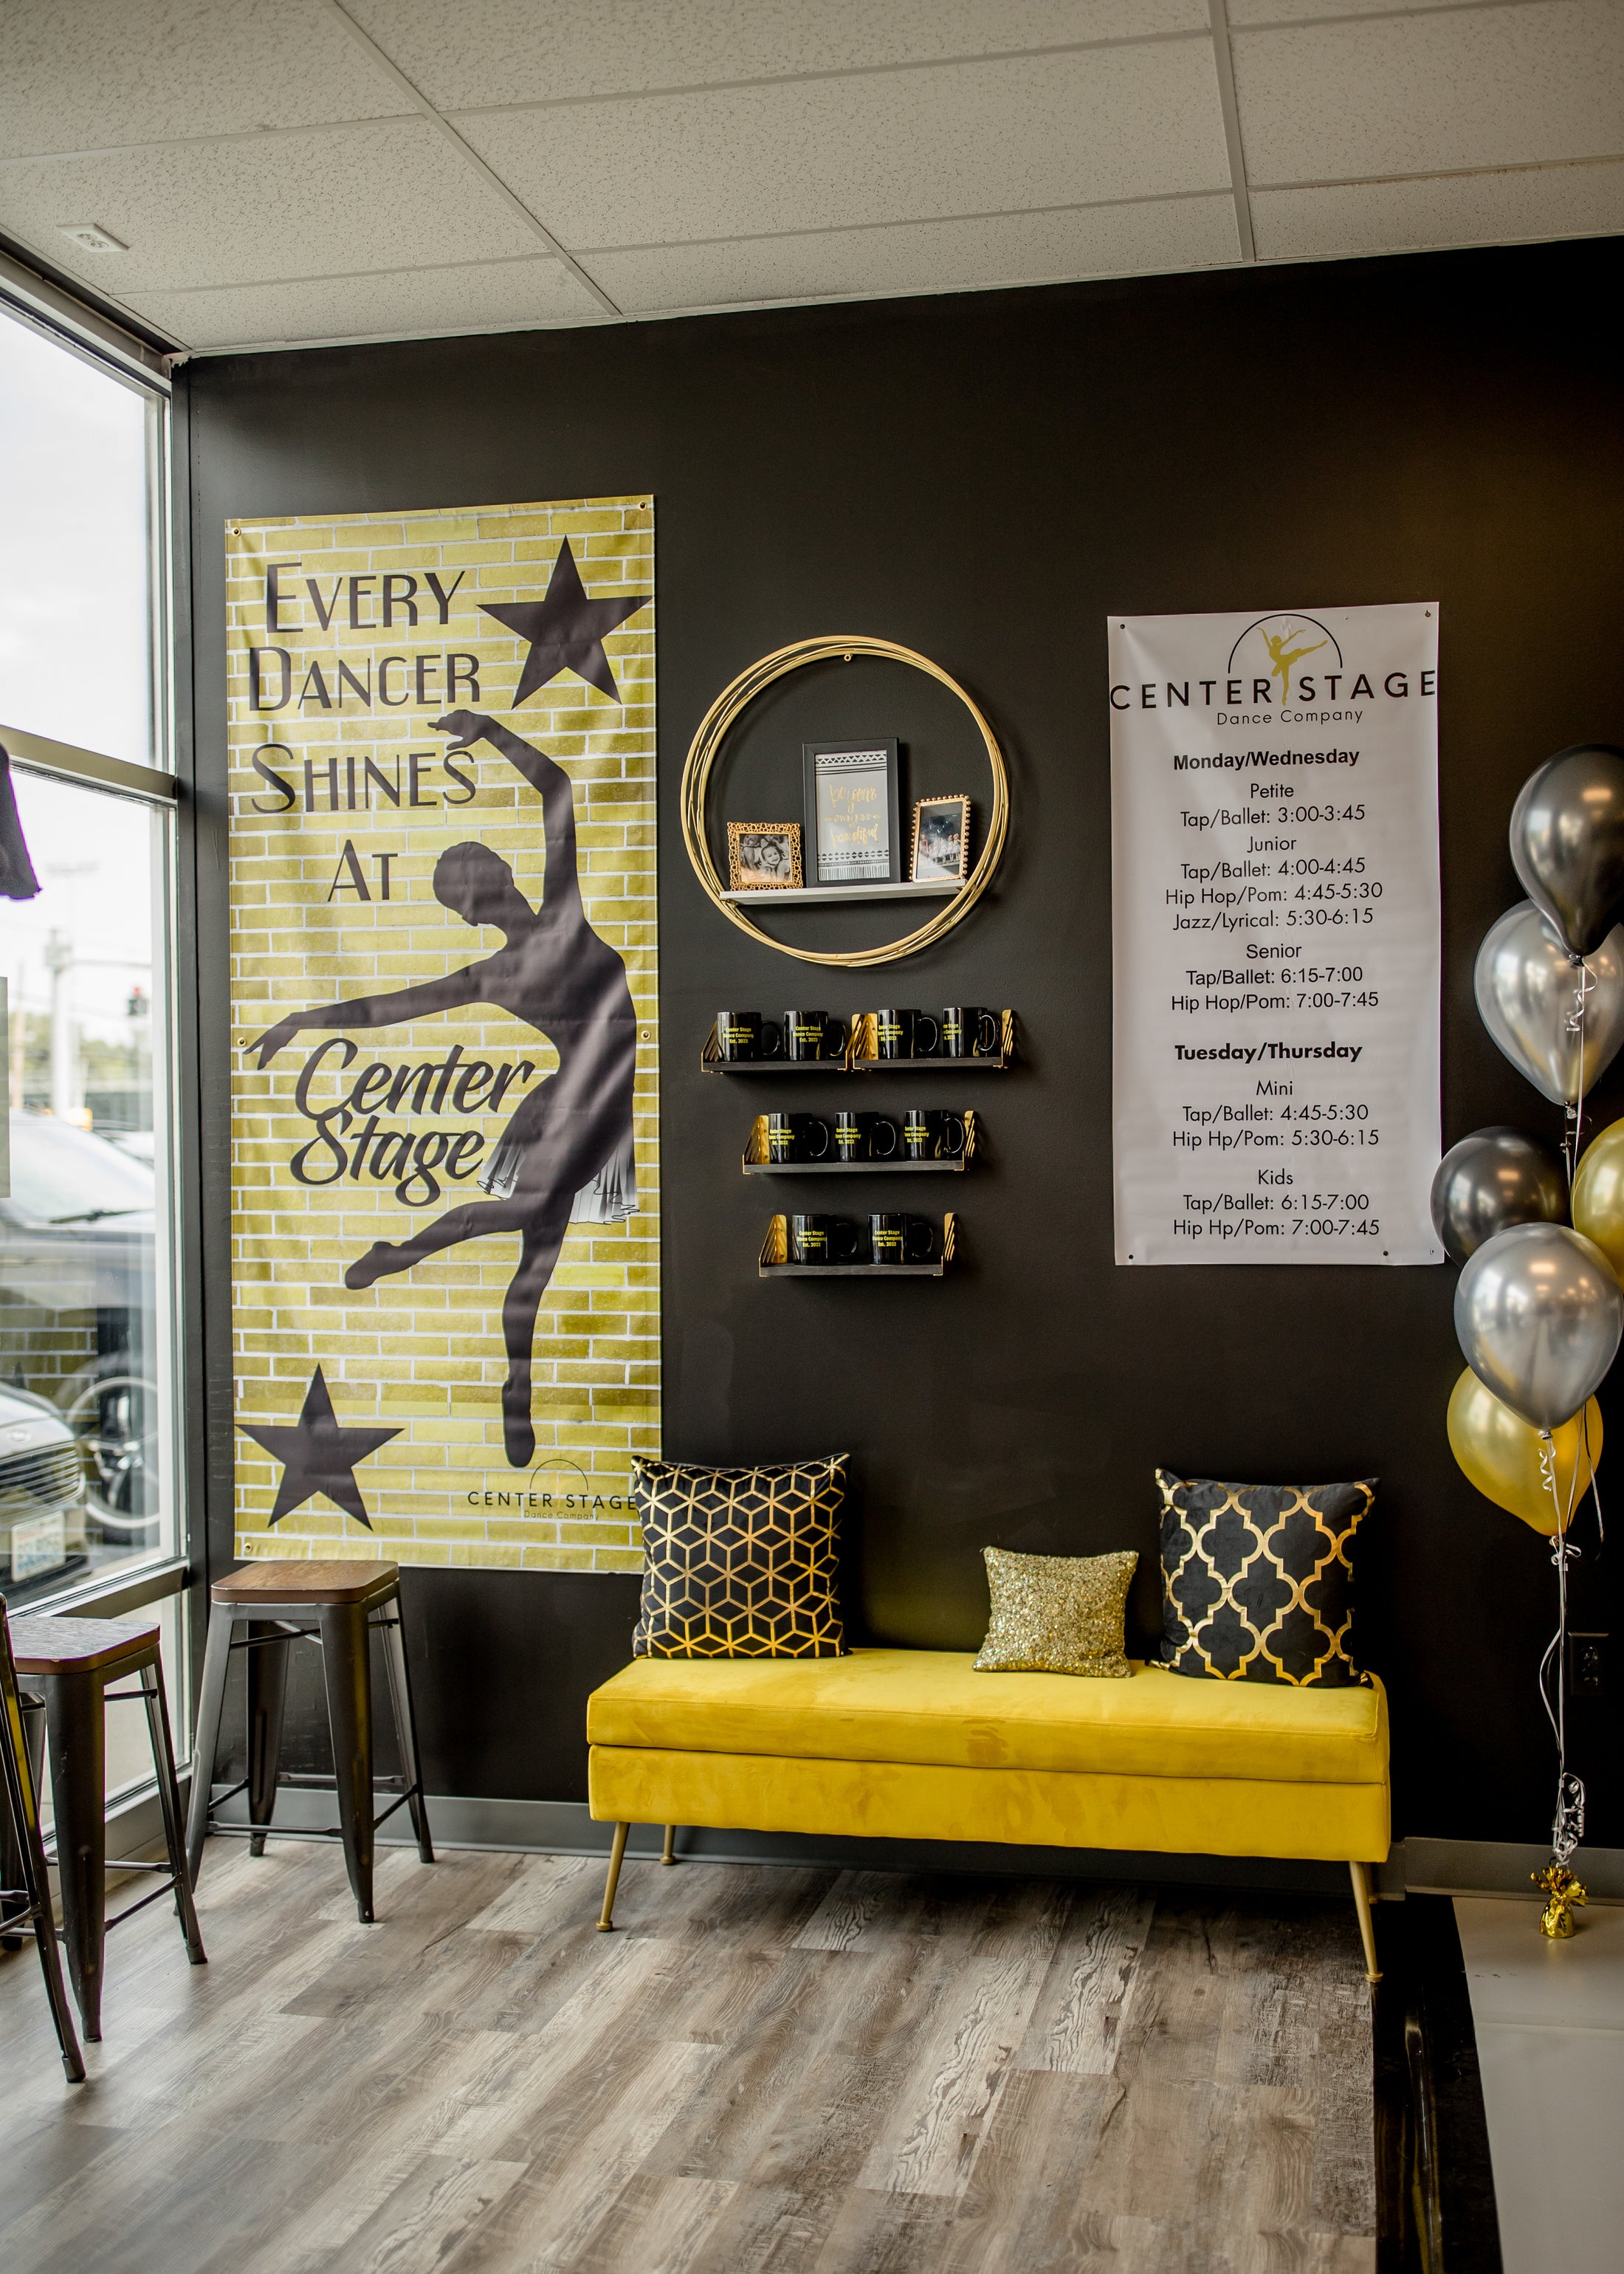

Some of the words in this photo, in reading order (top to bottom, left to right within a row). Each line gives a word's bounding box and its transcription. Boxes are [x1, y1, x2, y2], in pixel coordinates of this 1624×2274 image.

[1109, 678, 1273, 710] CENTER
[1298, 670, 1436, 702] STAGE
[1217, 712, 1272, 726] Dance
[1280, 710, 1363, 726] Company
[1174, 748, 1360, 772] Monday/Wednesday
[1250, 783, 1295, 799] Petite
[1180, 806, 1270, 831] Tap/Ballet:
[1278, 804, 1366, 823] 3:00-3:45
[1246, 836, 1297, 853] Junior
[1180, 859, 1270, 884] Tap/Ballet:
[1277, 856, 1366, 876] 4:00-4:45
[1166, 888, 1195, 909] Hip
[1201, 885, 1287, 908] Hop/Pom:
[1294, 882, 1383, 901] 4:45-5:30
[1172, 909, 1279, 933] Jazz/Lyrical:
[1286, 907, 1374, 927] 5:30-6:15
[1245, 943, 1303, 959] Senior
[1185, 969, 1275, 989] Tap/Ballet:
[1281, 966, 1363, 983] 6:15-7:00
[1171, 995, 1200, 1014] Hip
[1205, 994, 1290, 1014] Hop/Pom:
[1296, 991, 1379, 1009] 7:00-7:45
[1174, 1040, 1363, 1065] Tuesday/Thursday
[295, 1037, 535, 1121] Center
[1256, 1079, 1293, 1096] Mini
[1182, 1104, 1273, 1127] Tap/Ballet:
[1280, 1104, 1369, 1121] 4:45-5:30
[1173, 1130, 1202, 1152] Hip
[1208, 1129, 1284, 1151] Hp/Pom:
[1291, 1129, 1379, 1146] 5:30-6:15
[289, 1107, 485, 1206] Stage
[1258, 1167, 1293, 1185] Kids
[1183, 1192, 1274, 1215] Tap/Ballet:
[1281, 1194, 1369, 1210] 6:15-7:00
[1174, 1219, 1202, 1240] Hip
[1209, 1217, 1285, 1240] Hp/Pom:
[1292, 1218, 1380, 1236] 7:00-7:45
[467, 1491, 553, 1508] CENTER
[565, 1494, 636, 1510] STAGE
[524, 1511, 553, 1519] Dance
[557, 1511, 599, 1521] Company
